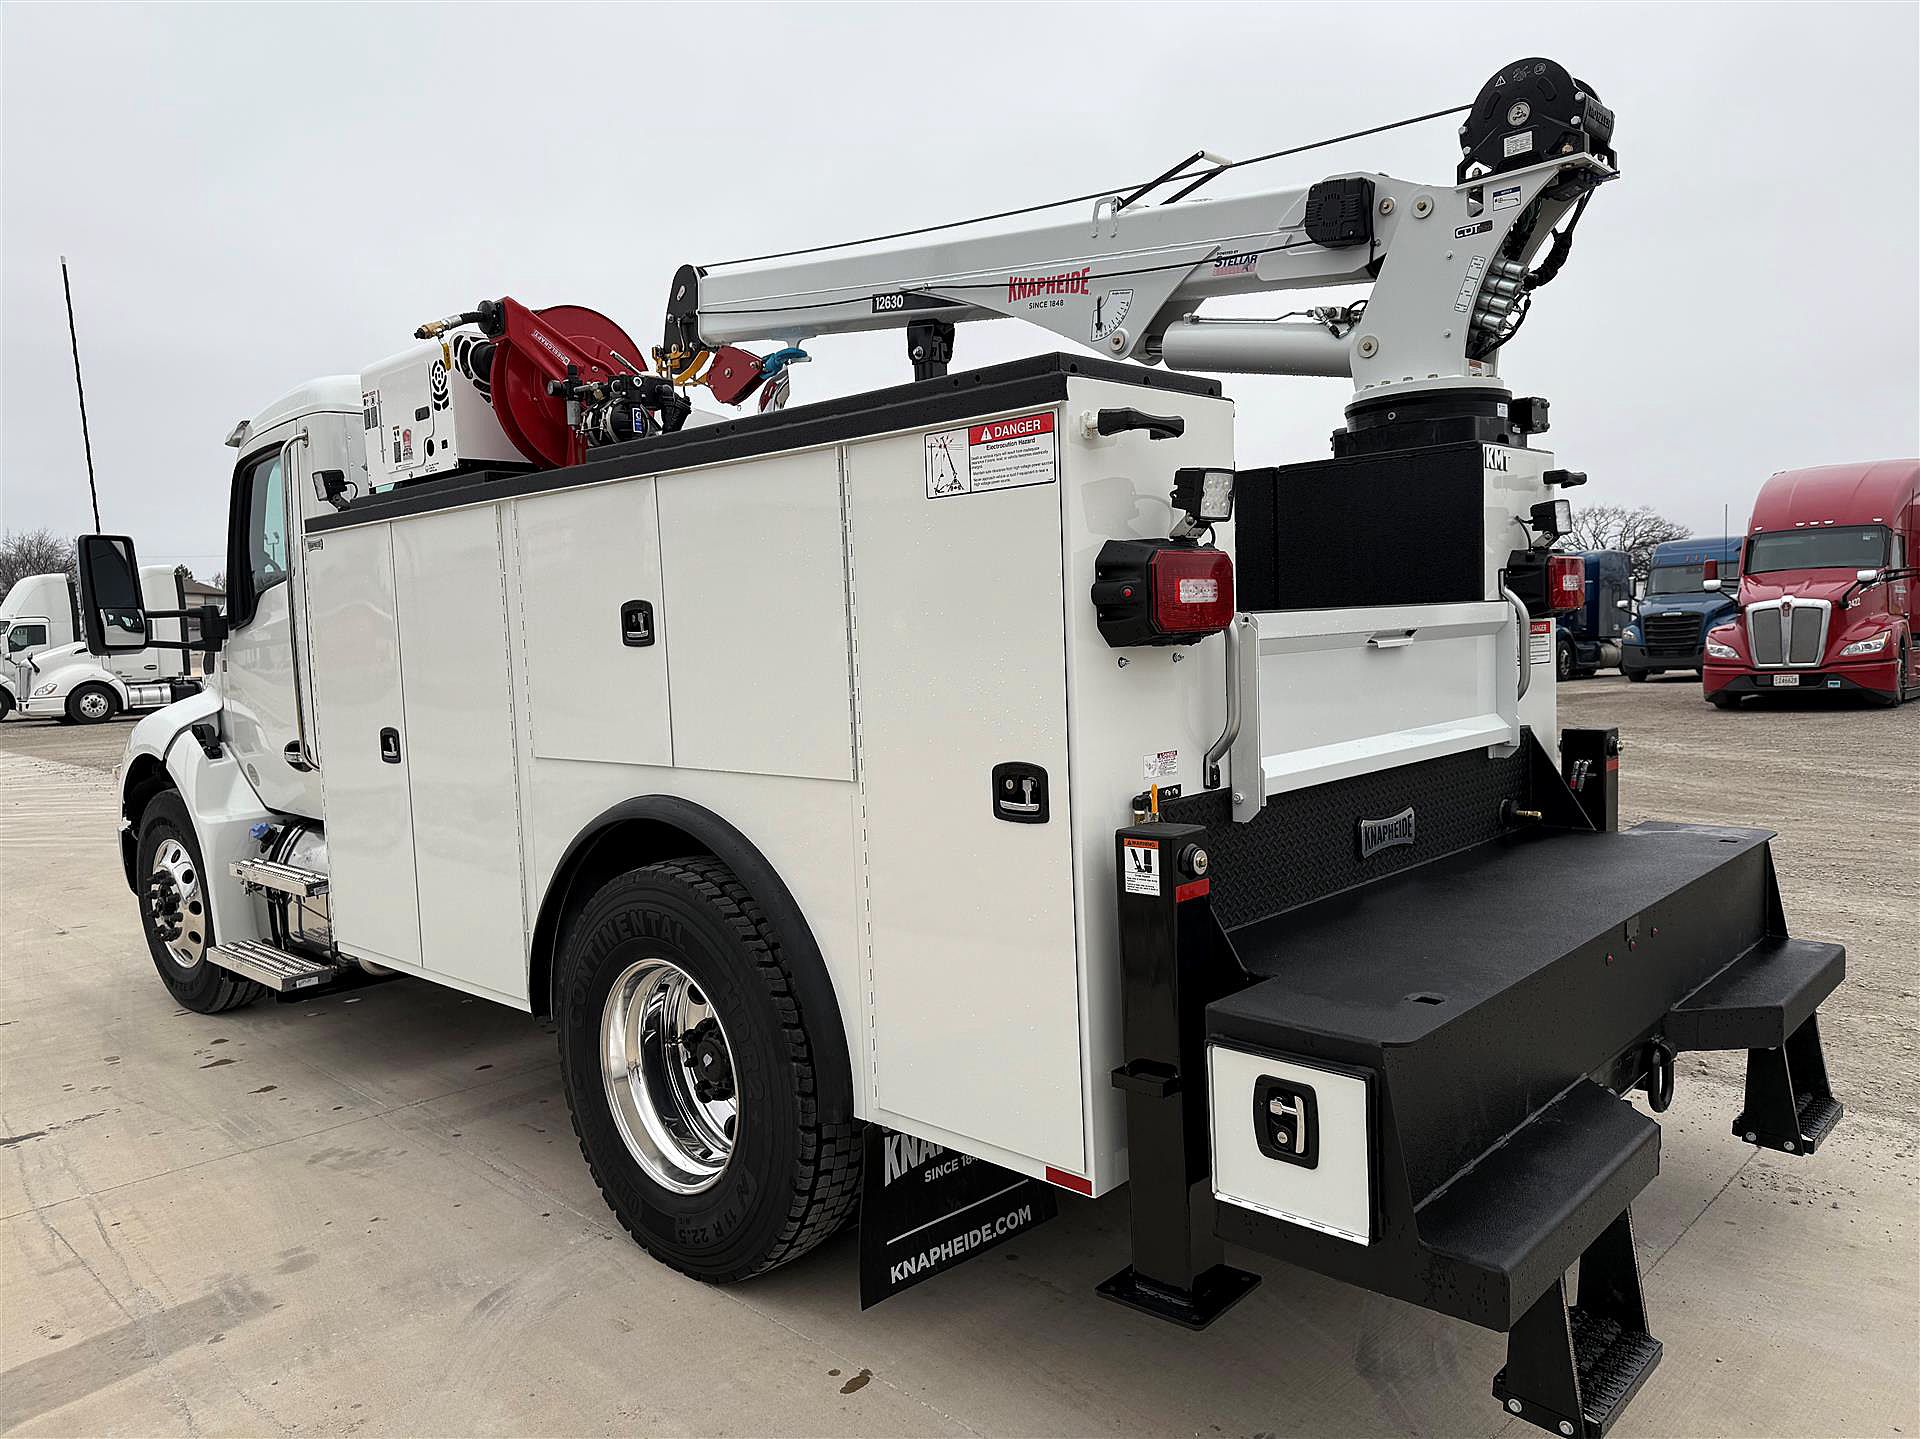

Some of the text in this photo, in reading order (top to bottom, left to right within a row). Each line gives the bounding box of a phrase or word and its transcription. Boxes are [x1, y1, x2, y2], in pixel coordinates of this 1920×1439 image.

[1456, 223, 1480, 238] CDT
[1215, 255, 1258, 267] STELLAR
[1008, 266, 1090, 303] KNAPHEIDE
[876, 294, 904, 311] 12630
[1028, 299, 1064, 310] SINCE 1848
[994, 419, 1041, 438] DANGER
[1364, 813, 1413, 852] KNAPHEIDE
[884, 1133, 943, 1188] KNA
[924, 1155, 978, 1183] SINCE 18
[890, 1204, 1032, 1285] KNAPHEIDE.COM
